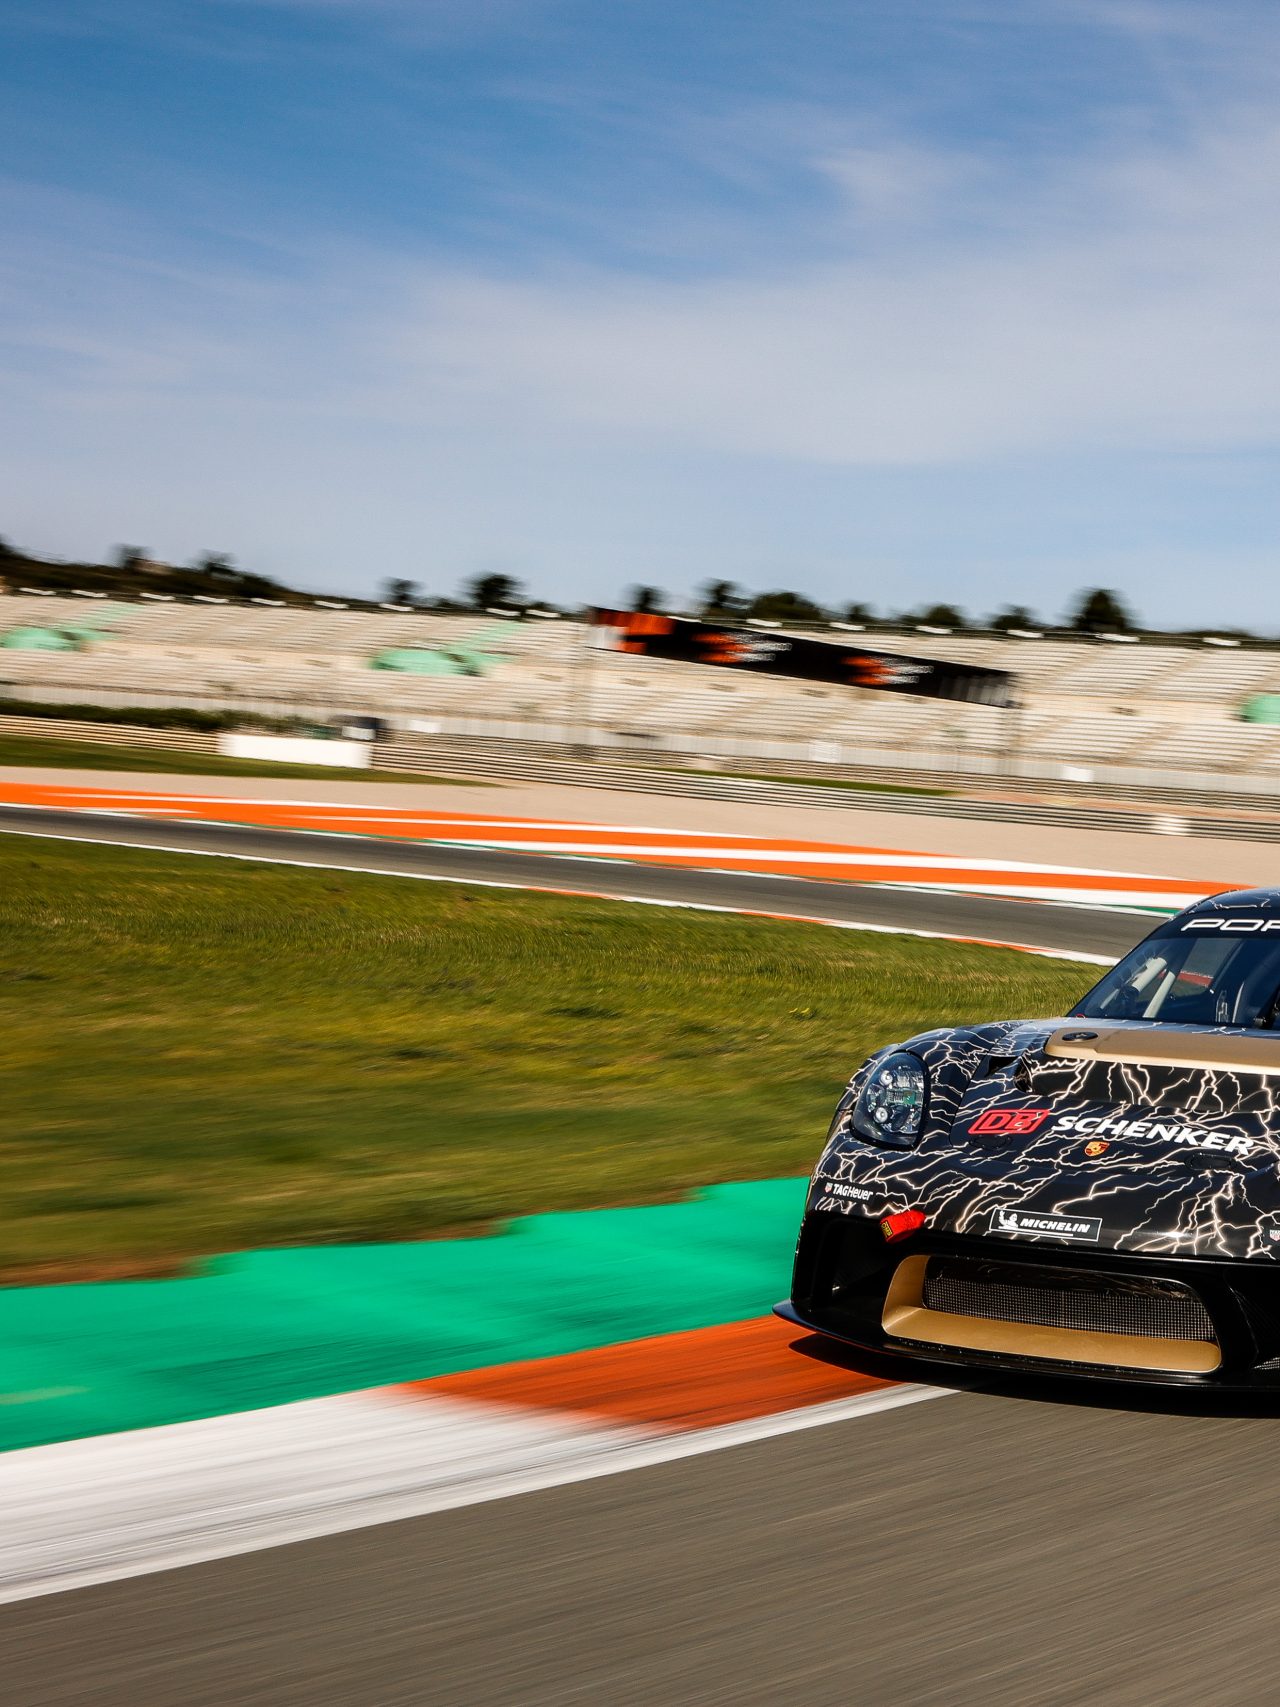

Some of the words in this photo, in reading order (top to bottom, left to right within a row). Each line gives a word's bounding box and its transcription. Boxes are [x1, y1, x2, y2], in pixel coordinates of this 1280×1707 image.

[976, 1111, 1036, 1132] DB
[1050, 1115, 1254, 1156] SCHENKER
[1019, 1217, 1091, 1234] MICHELIN
